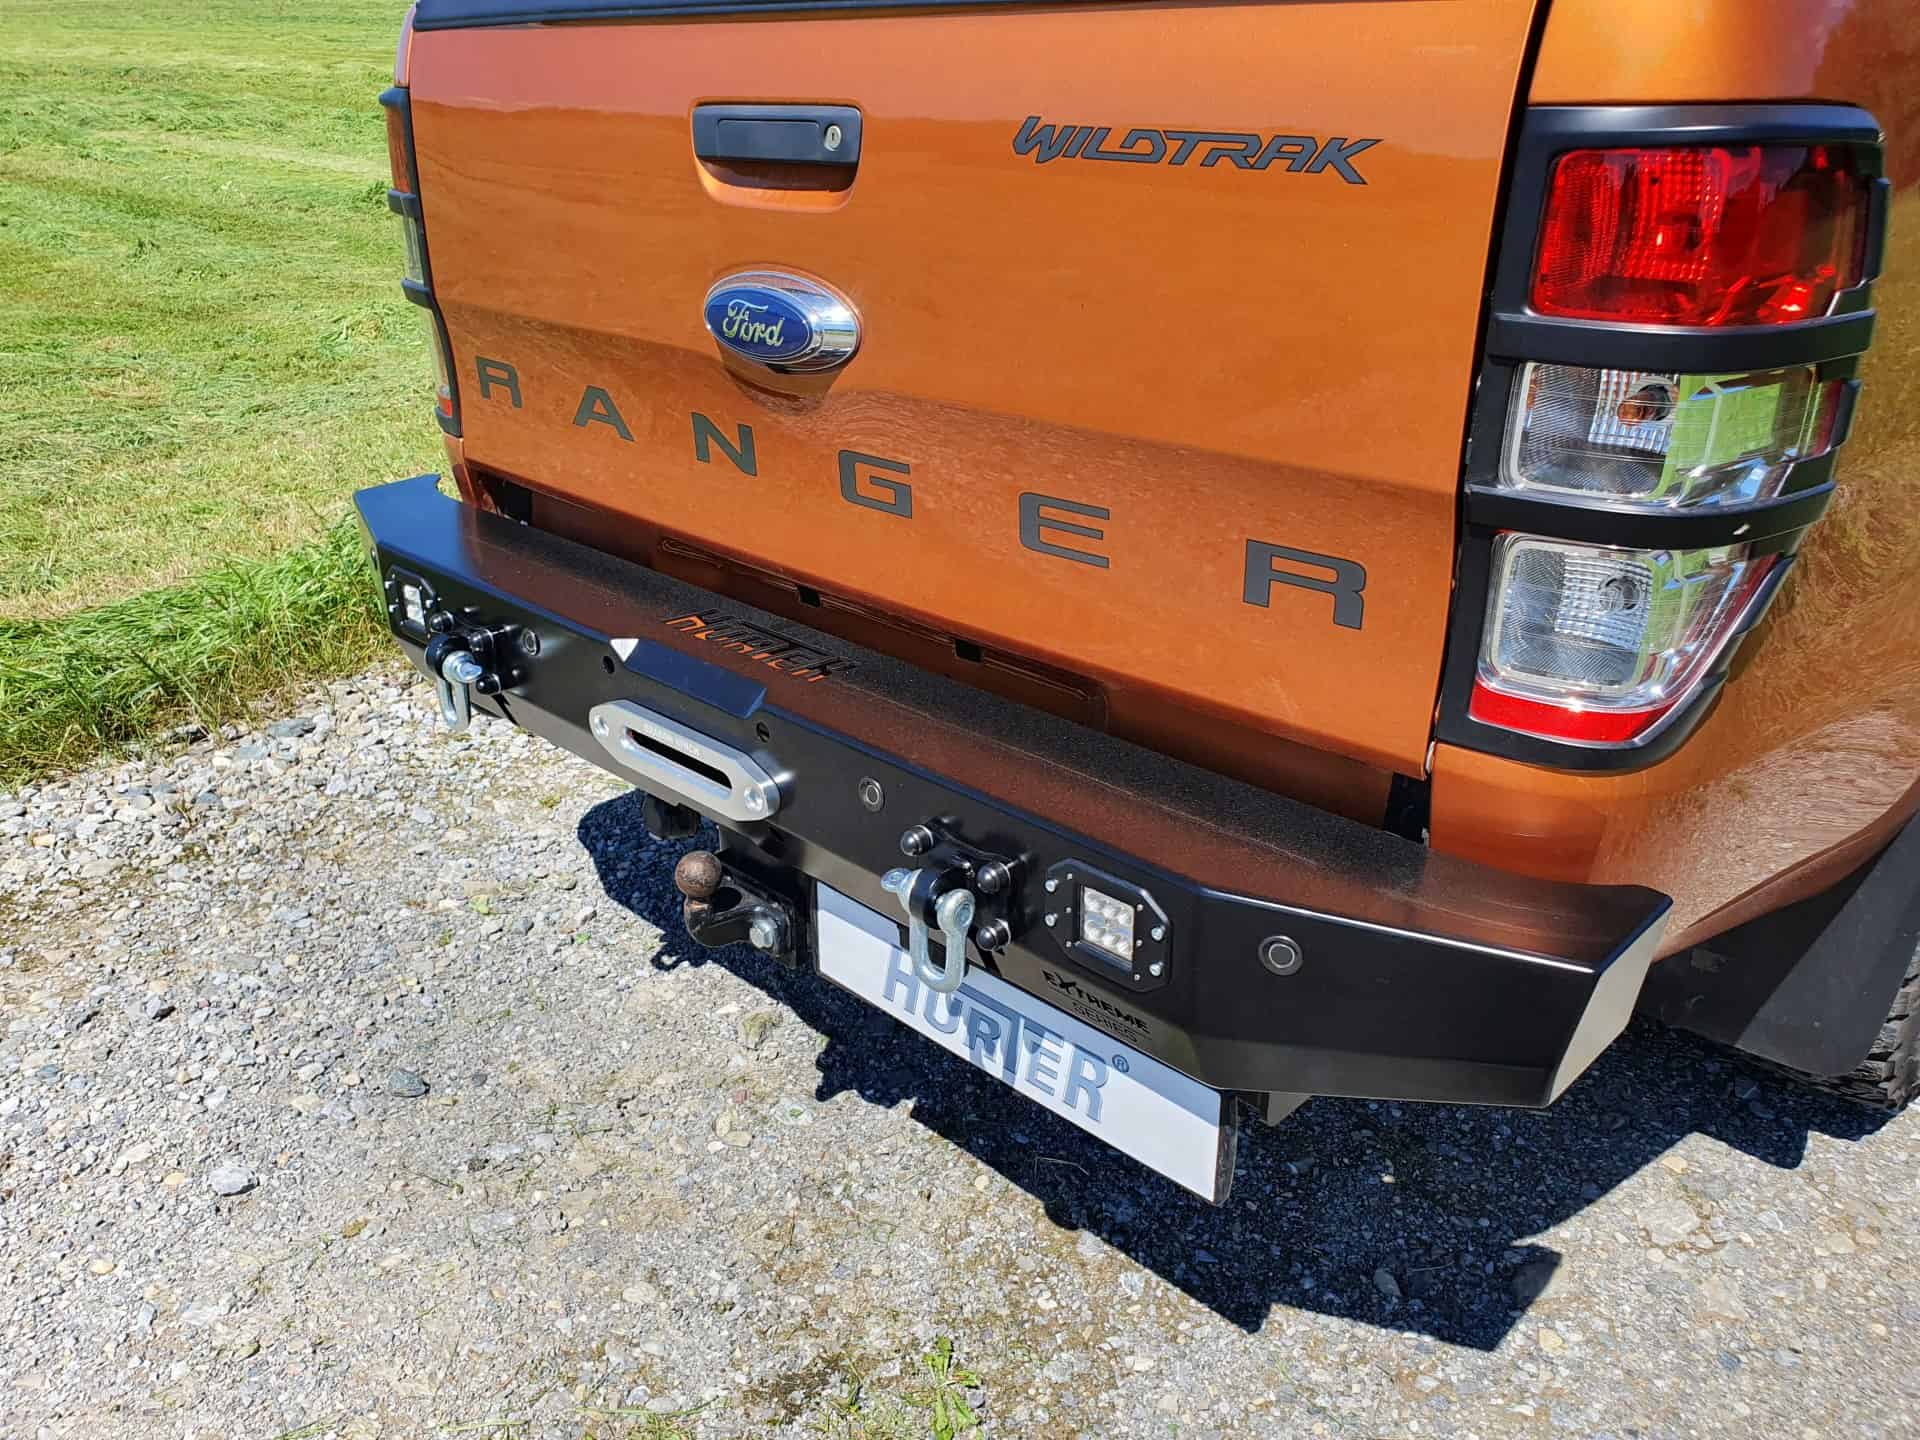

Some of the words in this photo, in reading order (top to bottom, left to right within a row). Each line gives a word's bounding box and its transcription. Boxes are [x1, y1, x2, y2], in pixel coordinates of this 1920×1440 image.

[1013, 115, 1384, 185] WILDTRAK
[722, 299, 785, 347] Ford
[476, 356, 1367, 630] RANGER
